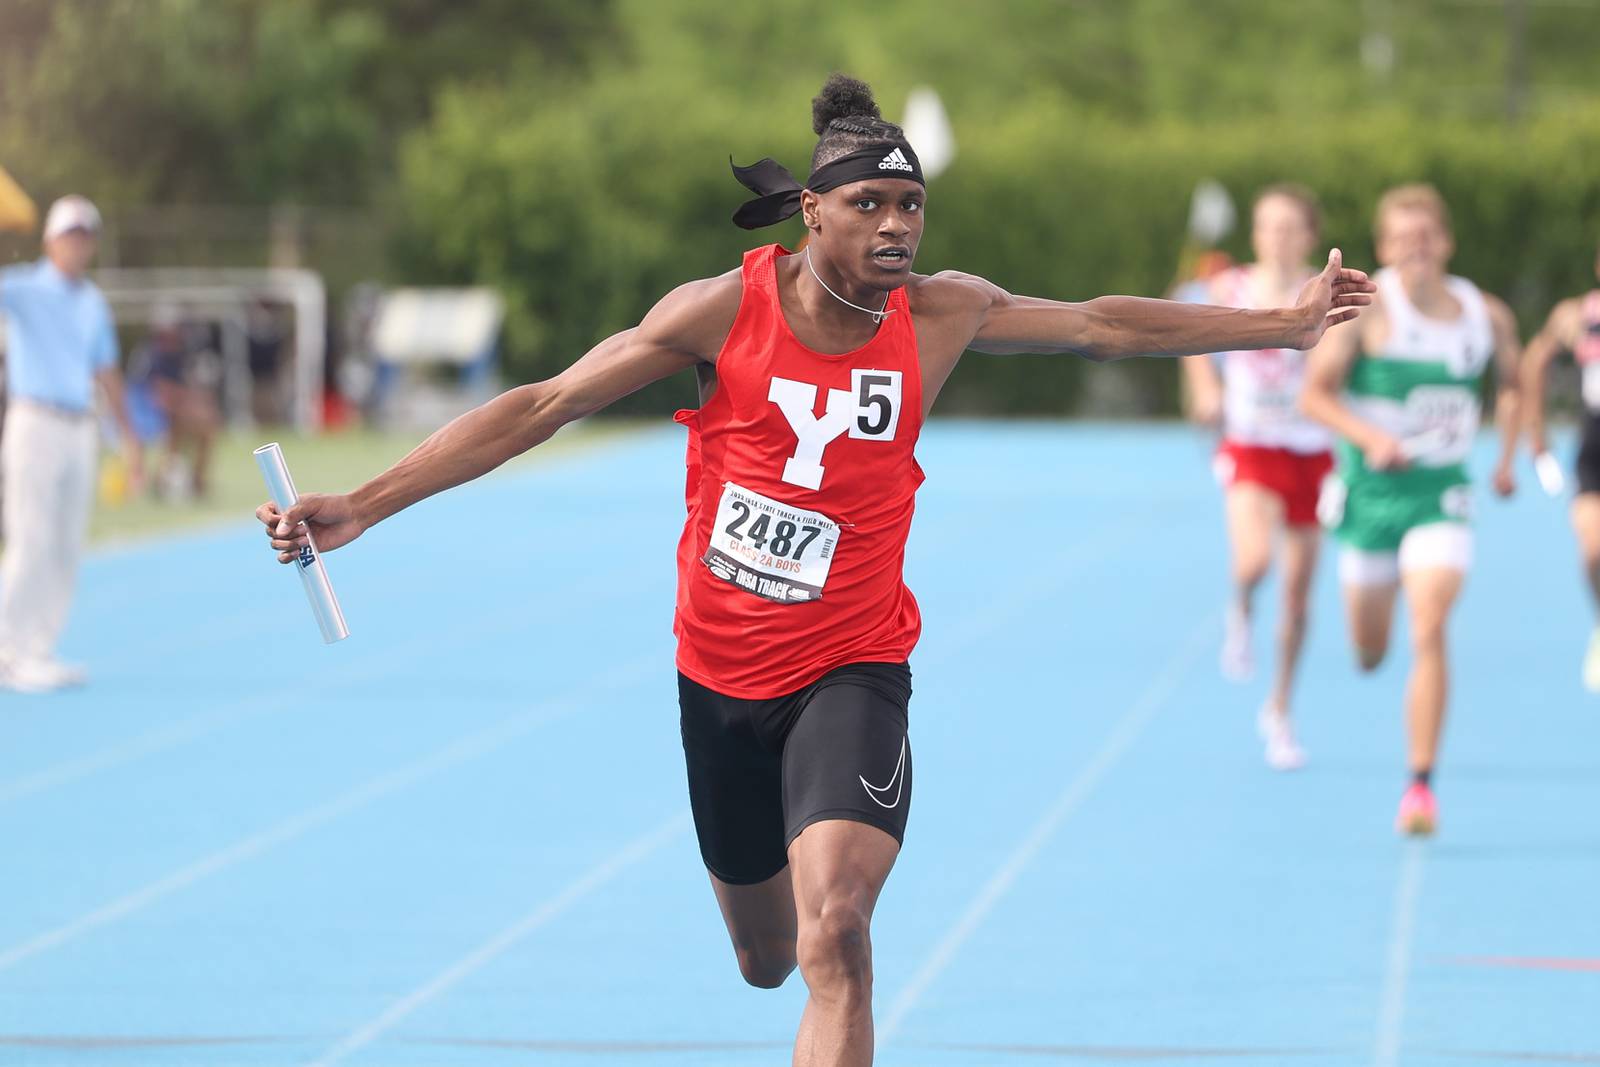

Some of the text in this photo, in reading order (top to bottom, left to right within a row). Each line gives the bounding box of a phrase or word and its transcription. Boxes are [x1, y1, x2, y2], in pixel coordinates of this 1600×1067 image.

[878, 161, 913, 172] adidas
[857, 375, 892, 436] 5
[767, 376, 852, 492] Y
[725, 500, 822, 561] 2487
[776, 509, 796, 521] TRACK
[818, 521, 834, 531] MEET
[300, 545, 316, 568] SA
[730, 539, 802, 574] CLASS 2A BOYS
[736, 568, 758, 591] IHSA
[757, 578, 790, 600] TRACK
